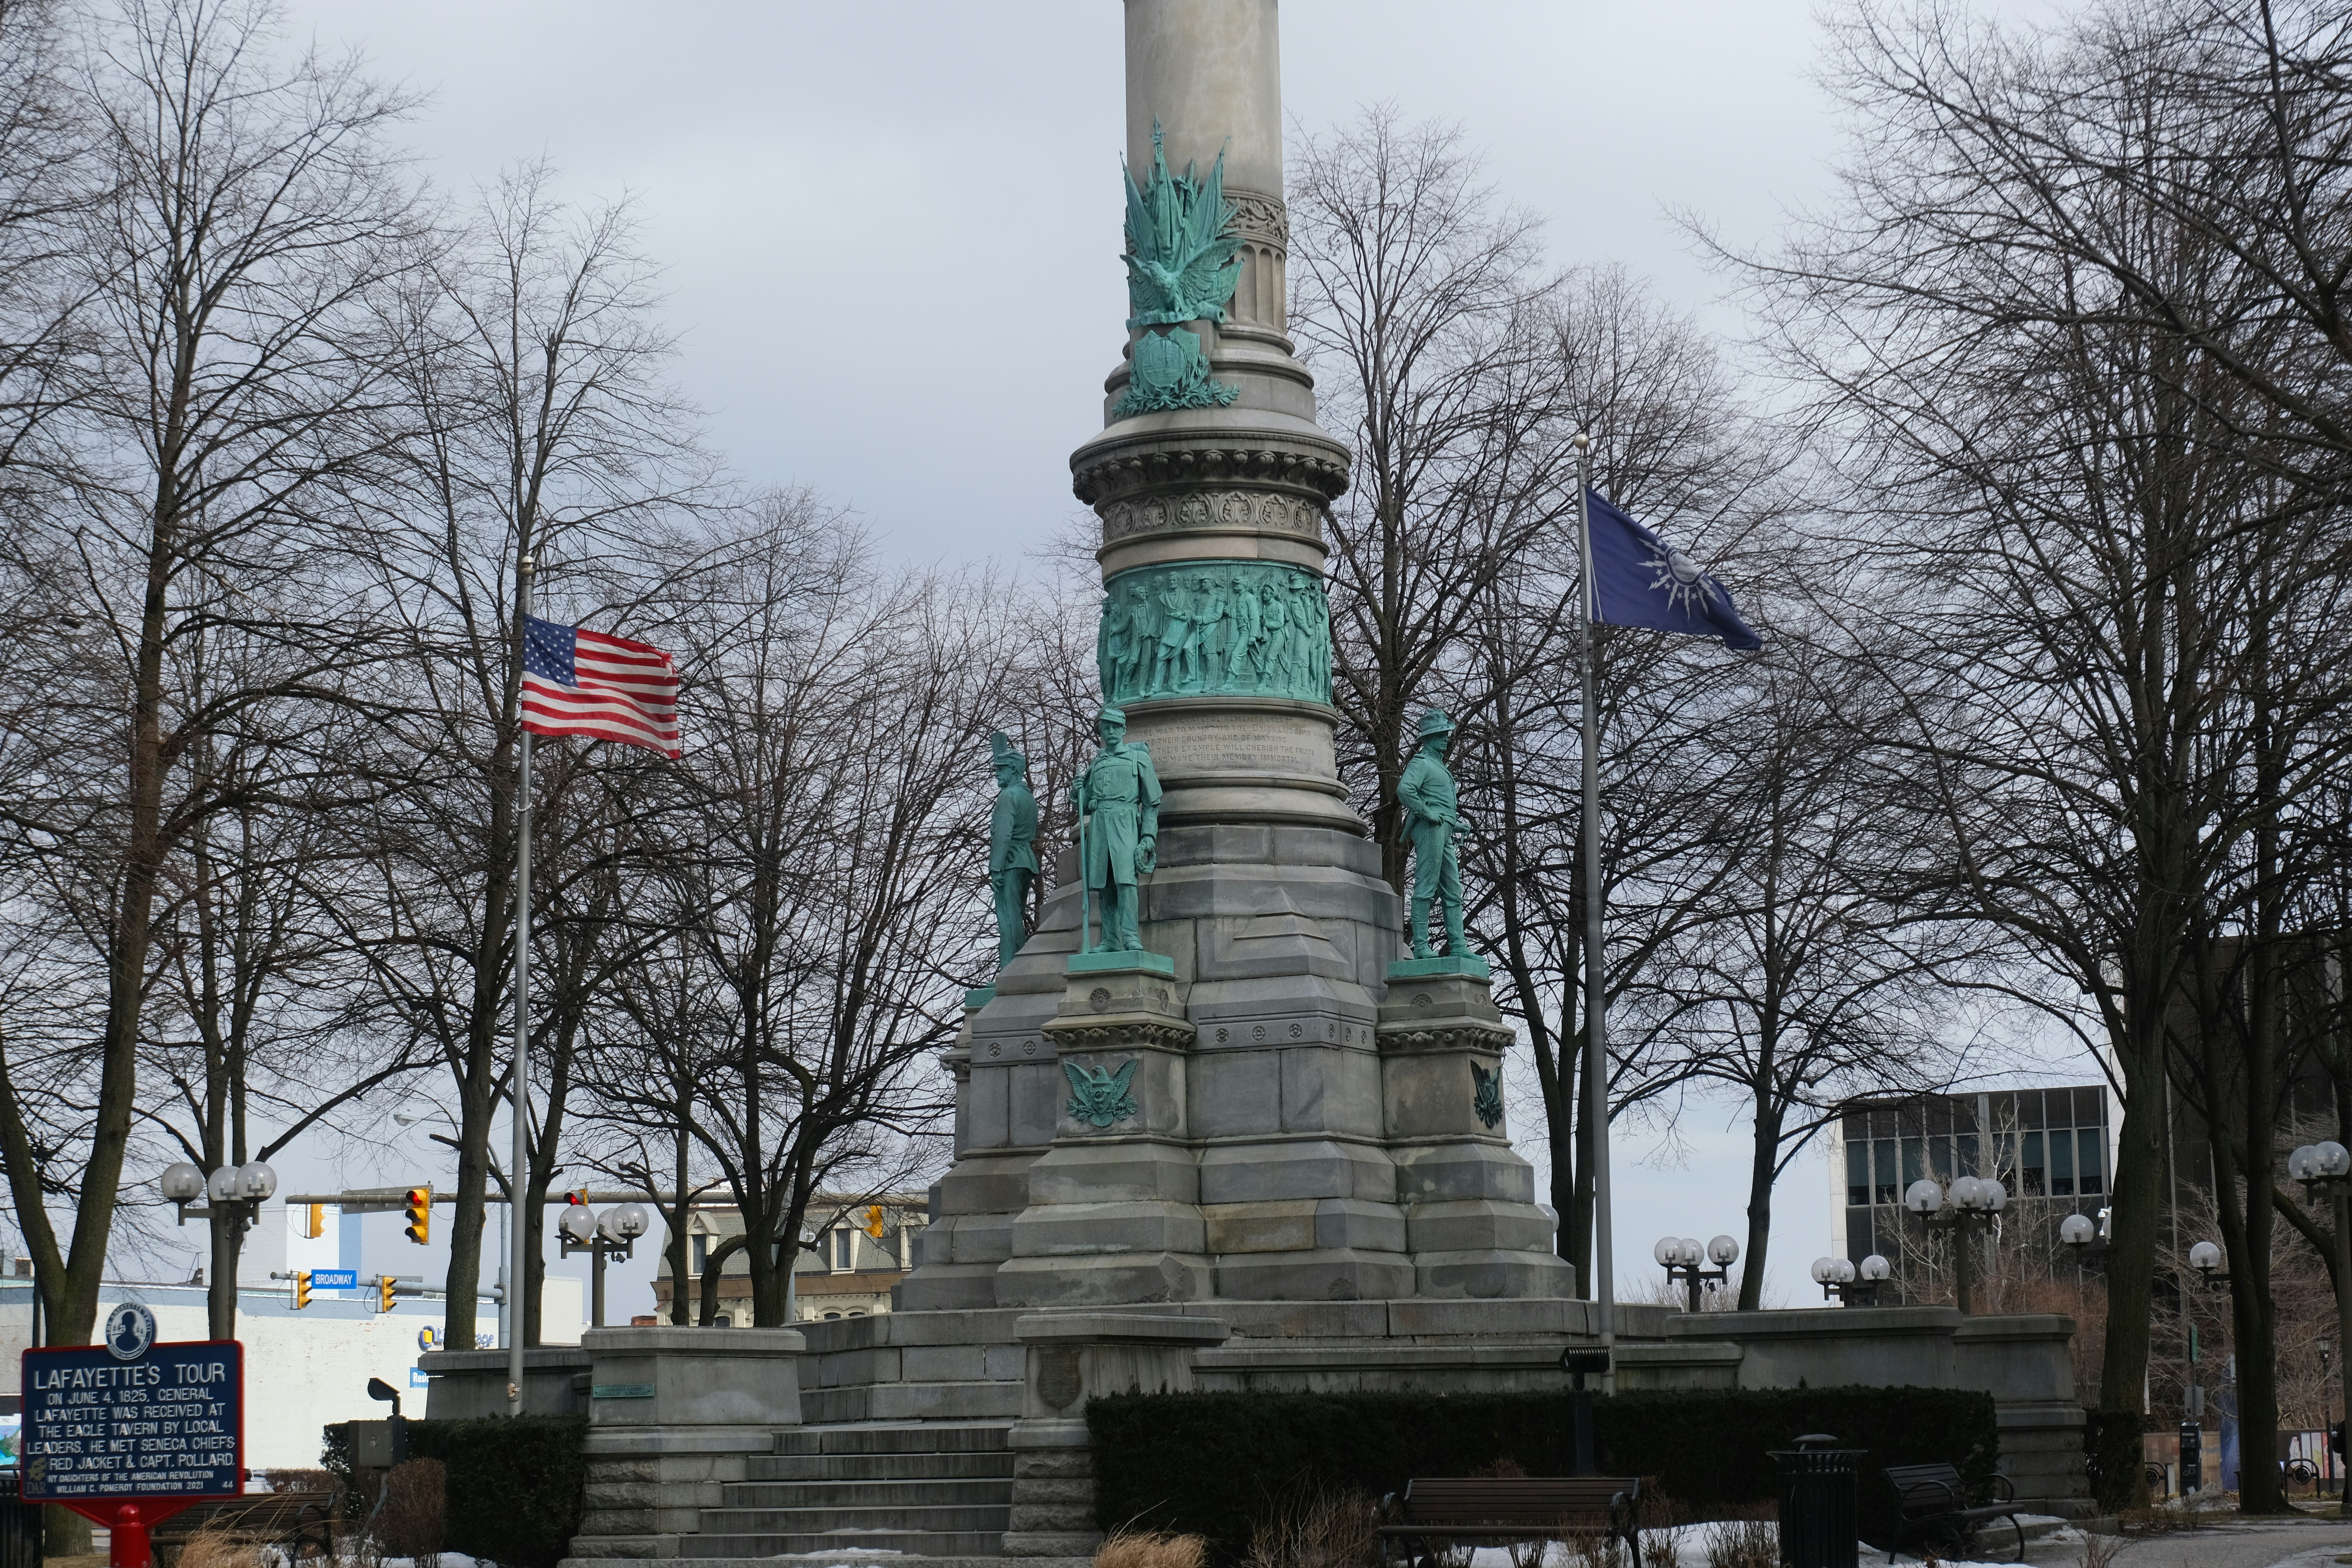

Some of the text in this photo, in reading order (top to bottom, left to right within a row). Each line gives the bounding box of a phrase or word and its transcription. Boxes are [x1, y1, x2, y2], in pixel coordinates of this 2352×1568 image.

[1158, 737, 1179, 745] THEIR
[1182, 735, 1217, 743] COUNTRY
[1170, 755, 1192, 763] MAKE
[1261, 754, 1301, 763] IMMORTAL.
[1295, 747, 1315, 756] FRUITS
[315, 1274, 352, 1285] BROADWAY
[111, 1303, 143, 1319] LAFAYETTE
[34, 1362, 225, 1389] LAFAYETTE'S TOUR
[46, 1393, 63, 1405] ON
[67, 1392, 99, 1404] JUNE
[157, 1387, 214, 1401] GENERAL
[35, 1403, 226, 1422] LAFAYETTE WAS RECEIVED AT
[38, 1420, 224, 1438] THE EAGLE TAVERN BY LOCAL
[89, 1440, 106, 1453] HE
[110, 1439, 136, 1452] MET
[140, 1438, 188, 1451] SENECA
[191, 1436, 235, 1450] CHIEFS
[48, 1453, 236, 1470] RED JACKET & CAPT. POLLARD.
[47, 1470, 214, 1483] NY DAUGHTERS OF THE AMERICAN REVOLUTION
[26, 1482, 47, 1494] DAR
[55, 1484, 86, 1493] WILLIAM
[100, 1483, 133, 1492] POMEROY
[136, 1481, 183, 1491] FOUNDATION
[187, 1481, 204, 1490] 2021
[222, 1480, 234, 1489] 44
